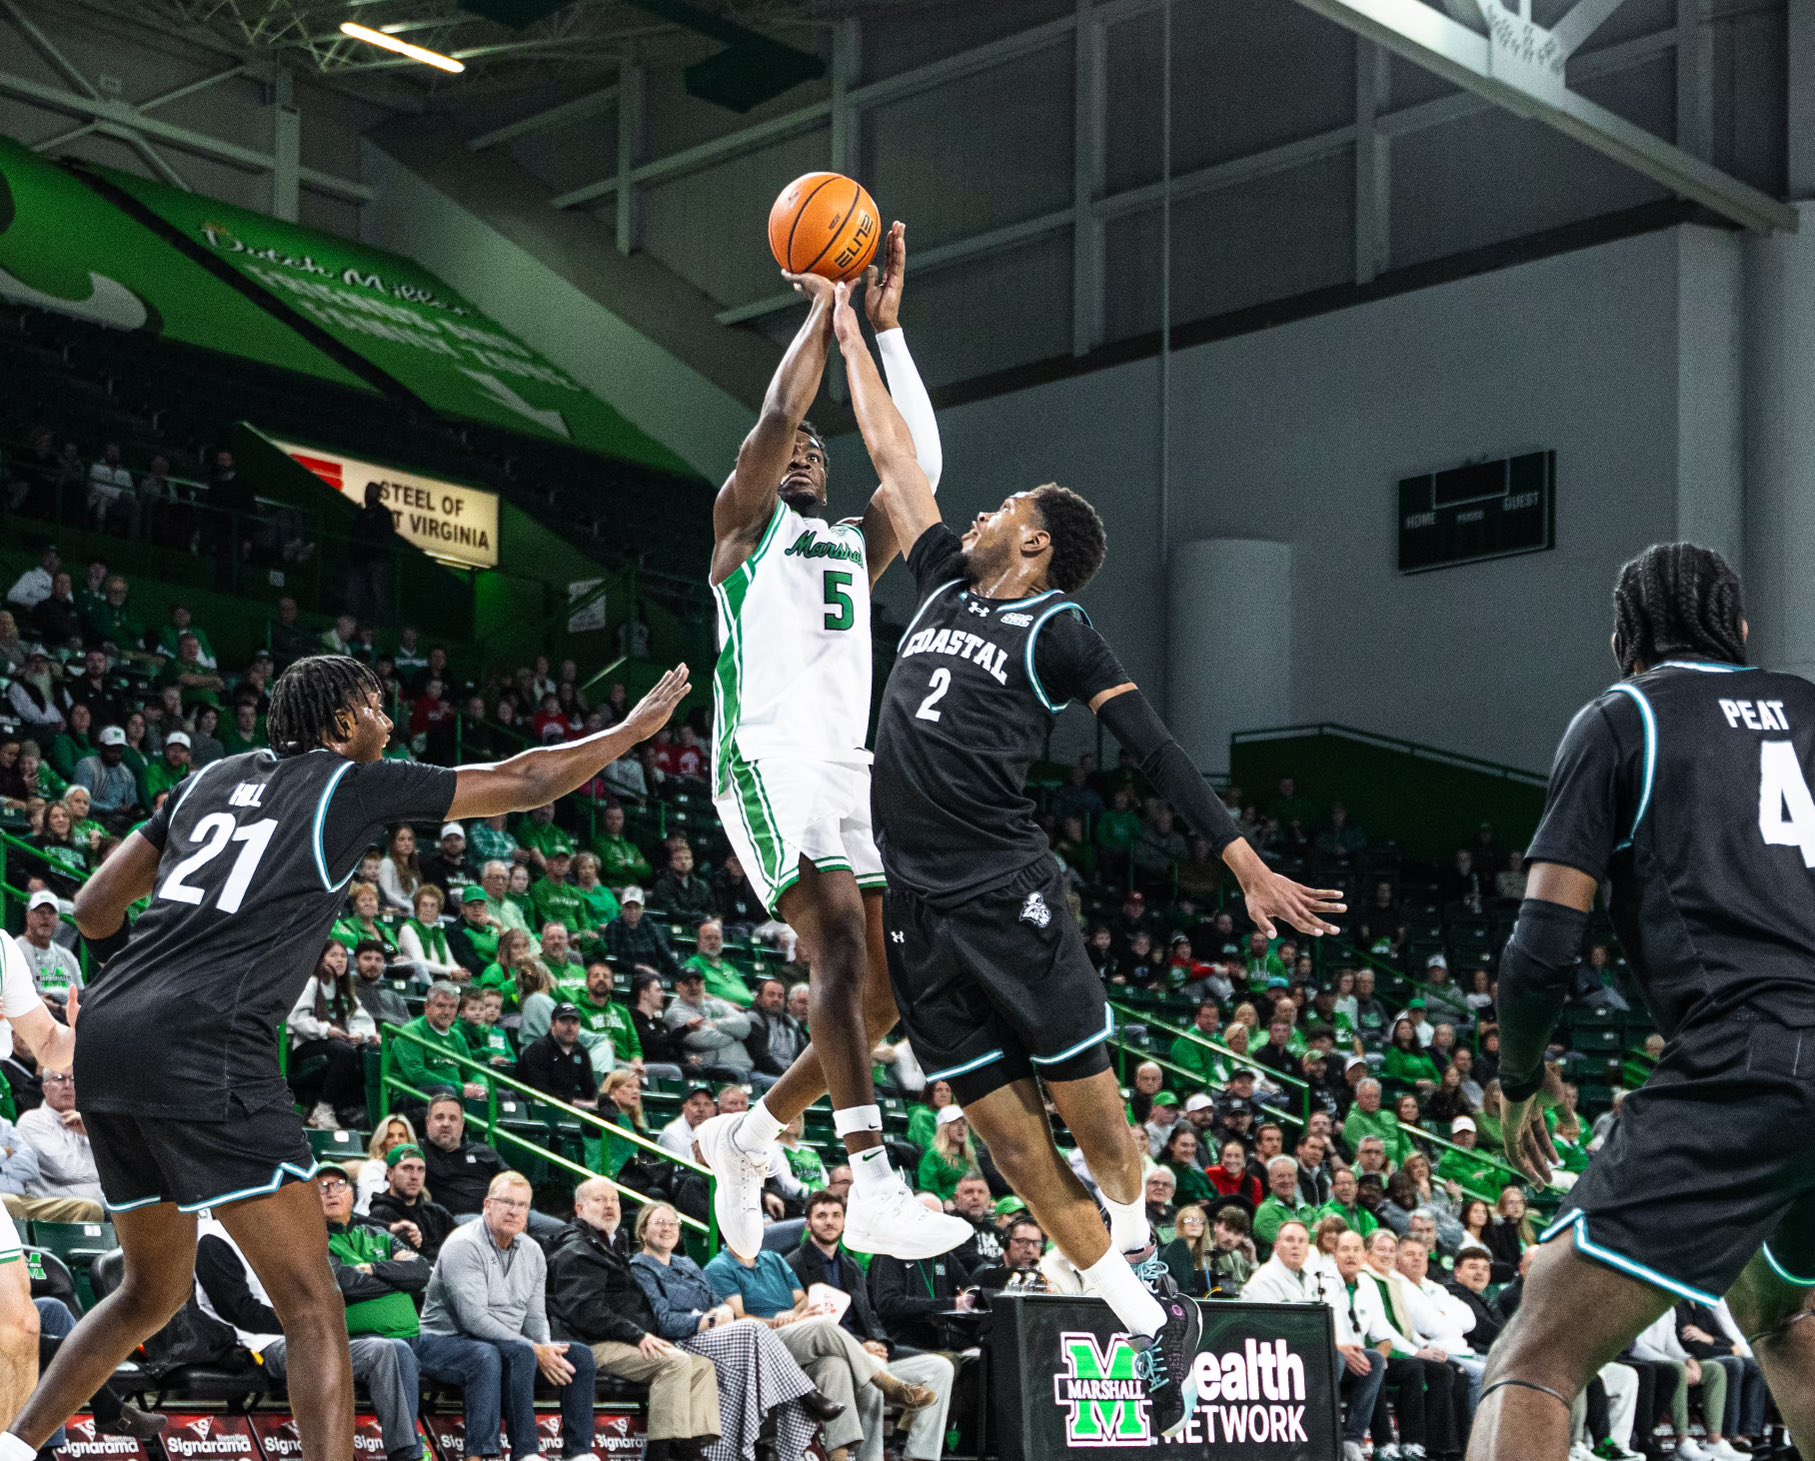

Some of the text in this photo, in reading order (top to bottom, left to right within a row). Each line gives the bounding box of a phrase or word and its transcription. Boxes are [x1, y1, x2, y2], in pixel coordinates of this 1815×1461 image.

[380, 481, 464, 516] STEEL OF
[1405, 512, 1436, 529] HOME
[410, 514, 489, 550] VIRGINIA
[823, 570, 854, 631] 5
[902, 628, 1008, 686] COASTAL
[915, 667, 951, 722] 2
[1718, 699, 1790, 730] PEAT
[1758, 741, 1815, 868] 4
[158, 812, 279, 914] 21
[1066, 1380, 1146, 1400] MARSHALL
[1193, 1338, 1306, 1400] ealth
[168, 1437, 252, 1457] Signarama
